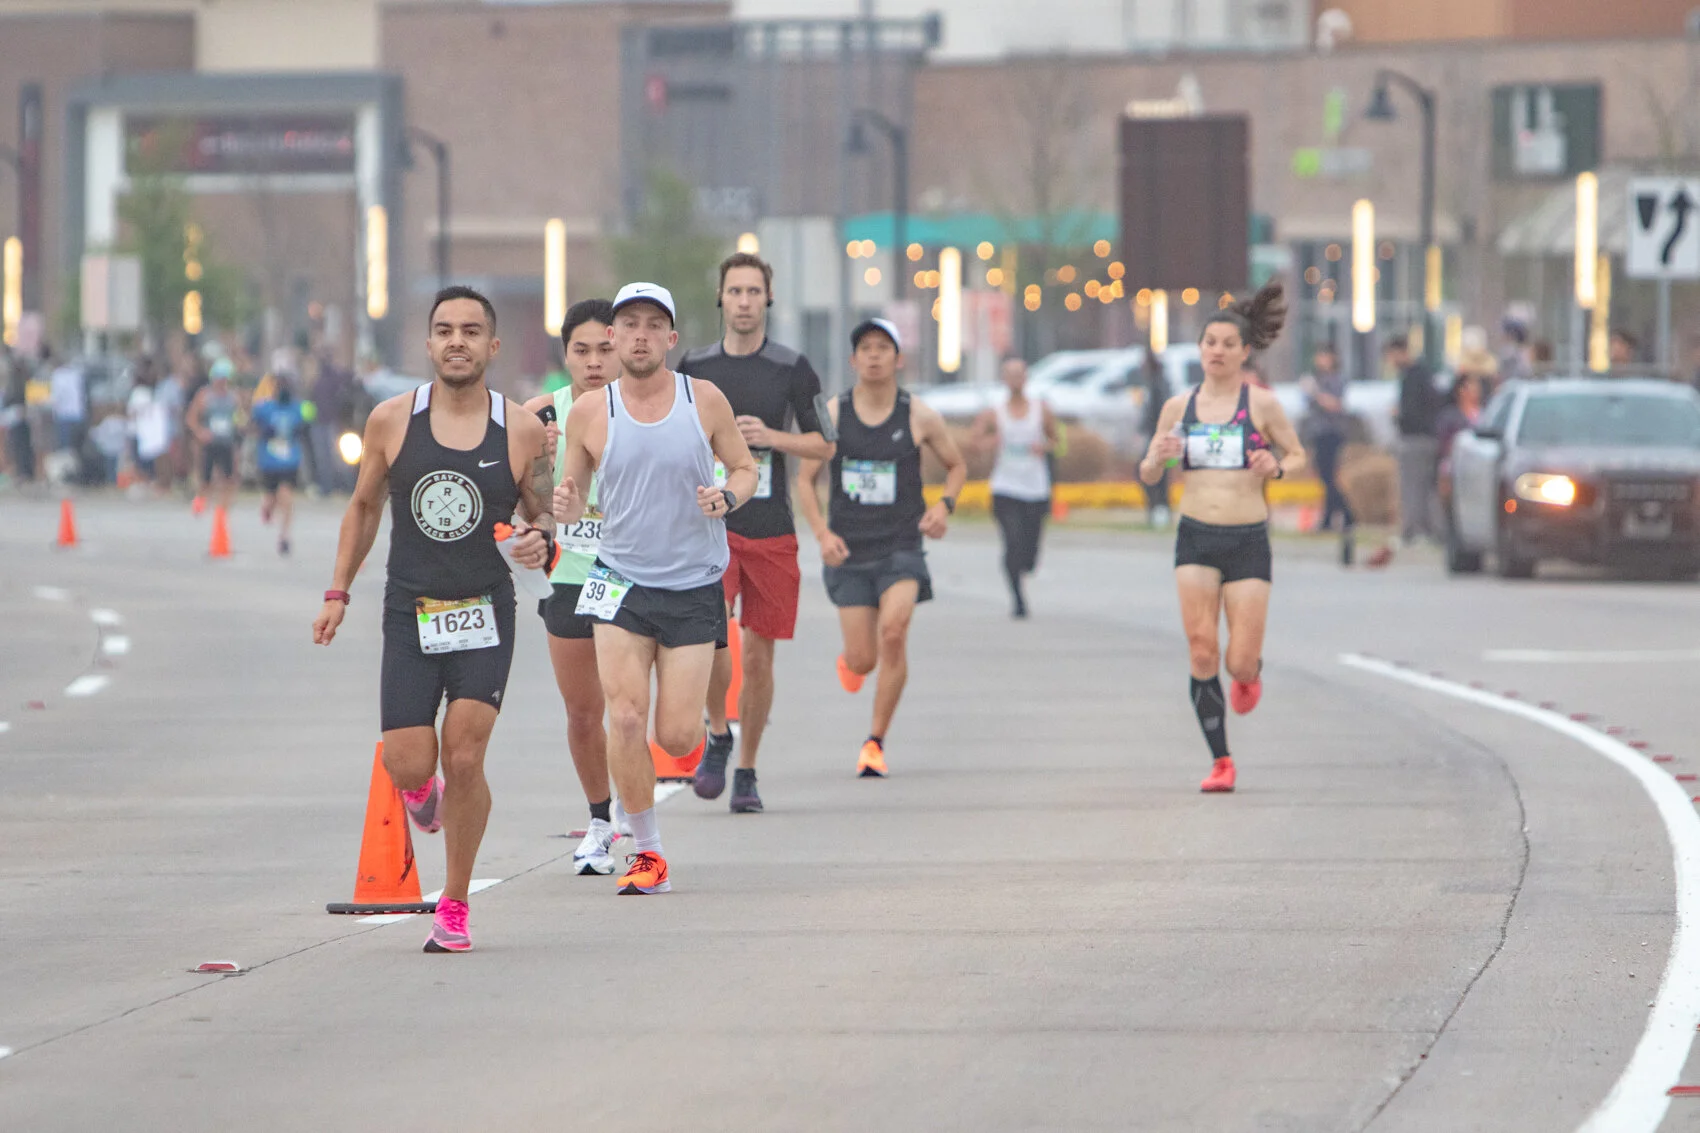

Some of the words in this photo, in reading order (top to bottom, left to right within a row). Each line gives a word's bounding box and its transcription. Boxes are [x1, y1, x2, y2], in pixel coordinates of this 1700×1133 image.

[1205, 436, 1224, 455] 32
[433, 474, 464, 485] RAY'S
[443, 487, 452, 496] R
[427, 500, 434, 509] T
[458, 503, 466, 513] C
[418, 517, 445, 539] TRACK
[448, 522, 473, 538] CLUB
[438, 517, 451, 526] 19
[586, 581, 606, 601] 39
[430, 608, 485, 635] 1623
